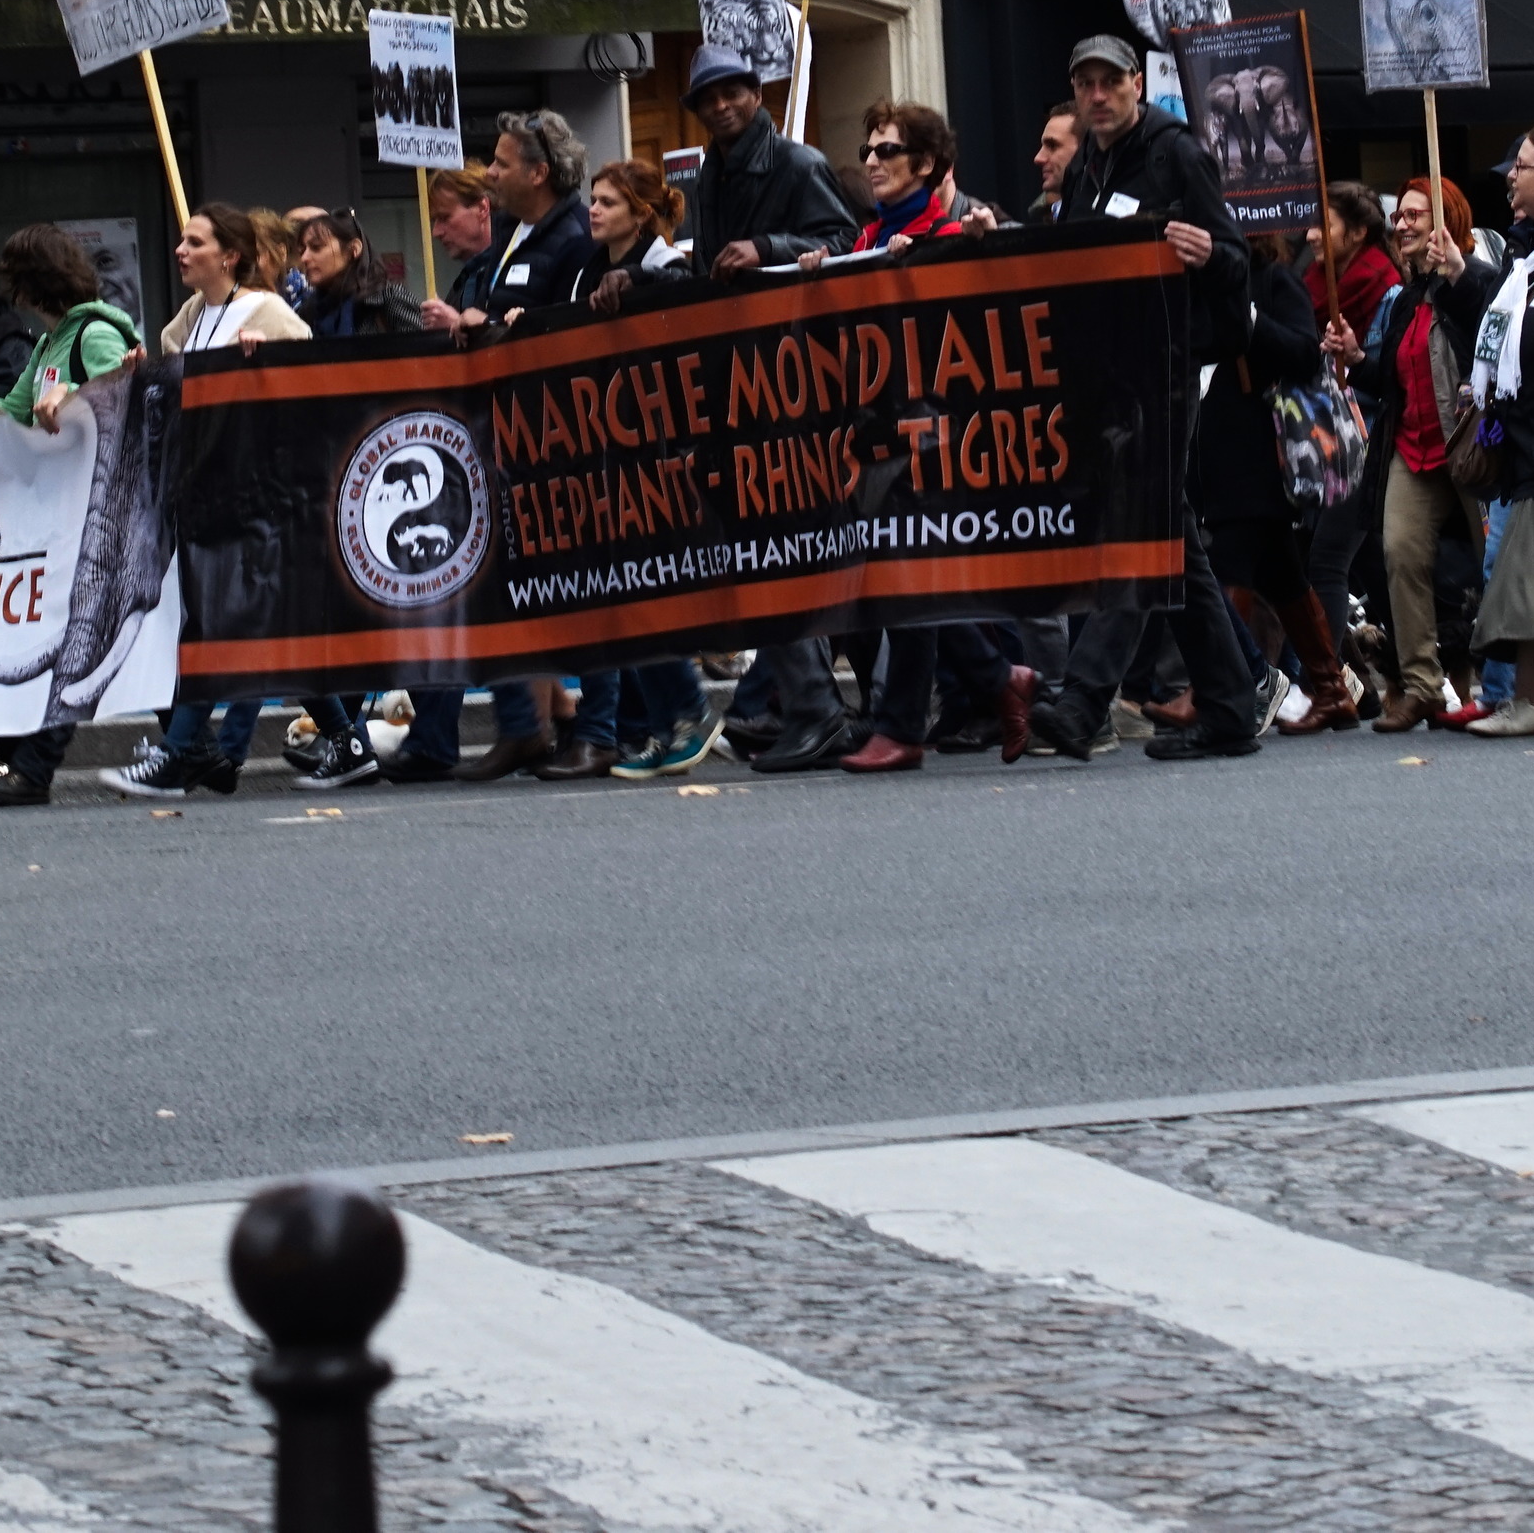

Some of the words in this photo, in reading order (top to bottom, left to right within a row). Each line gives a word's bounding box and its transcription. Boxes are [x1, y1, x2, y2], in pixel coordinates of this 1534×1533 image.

[1237, 204, 1282, 221] Planet
[1285, 201, 1318, 220] Tiger
[492, 351, 711, 472] MARCHE
[727, 301, 1060, 429] MONDIALE
[349, 432, 399, 501] GLOBAL
[404, 422, 466, 454] MARCH
[465, 451, 481, 493] FOR
[512, 450, 703, 557] ELEPHANTS
[733, 422, 861, 520] RHINOS
[897, 402, 1070, 493] TIGRES
[347, 524, 400, 594] ELEPHANTS
[405, 564, 461, 596] RHINOS
[461, 515, 485, 565] LIONS
[507, 503, 1076, 610] WWW.MARCH4ELEPHANTSANDRHINOS.ORG
